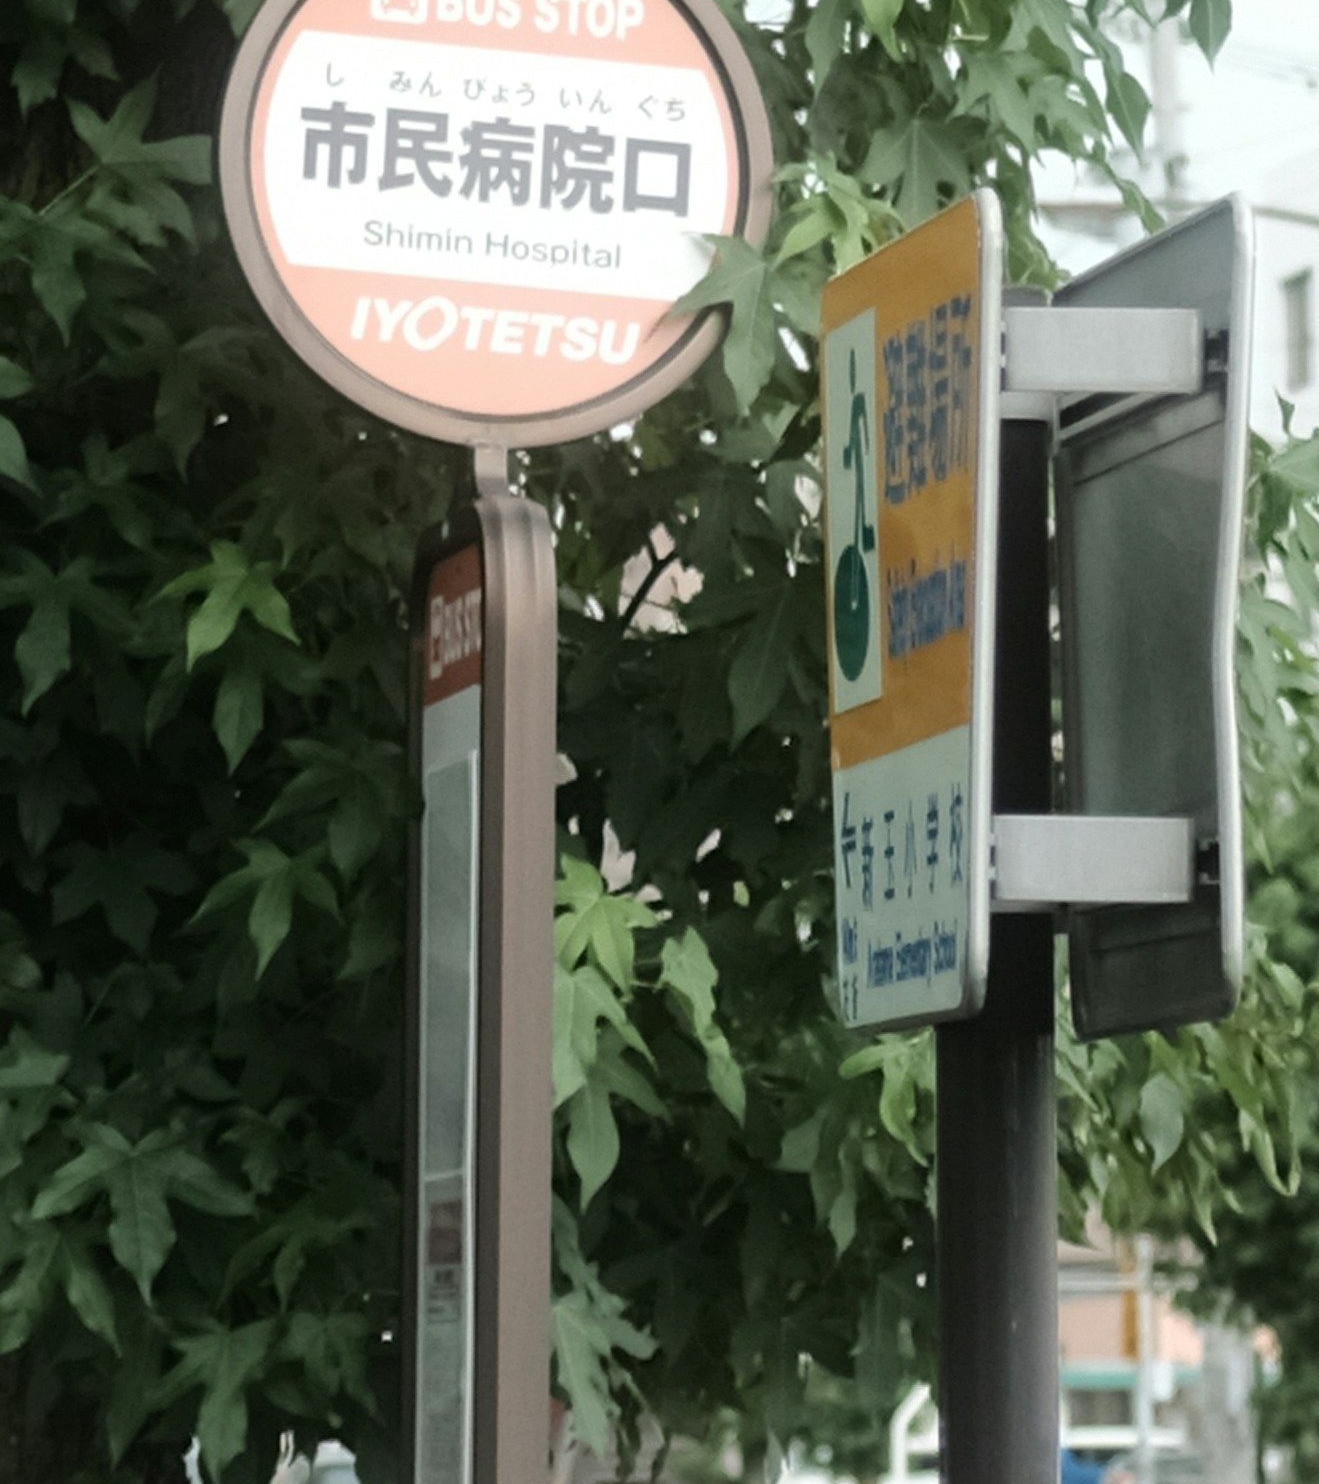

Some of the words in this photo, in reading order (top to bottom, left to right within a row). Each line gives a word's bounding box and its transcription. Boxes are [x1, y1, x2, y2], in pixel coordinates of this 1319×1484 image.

[300, 100, 692, 218] 市民病院口
[363, 219, 474, 256] Shimin
[484, 232, 622, 270] Hospital
[350, 294, 642, 366] IYOTETSU
